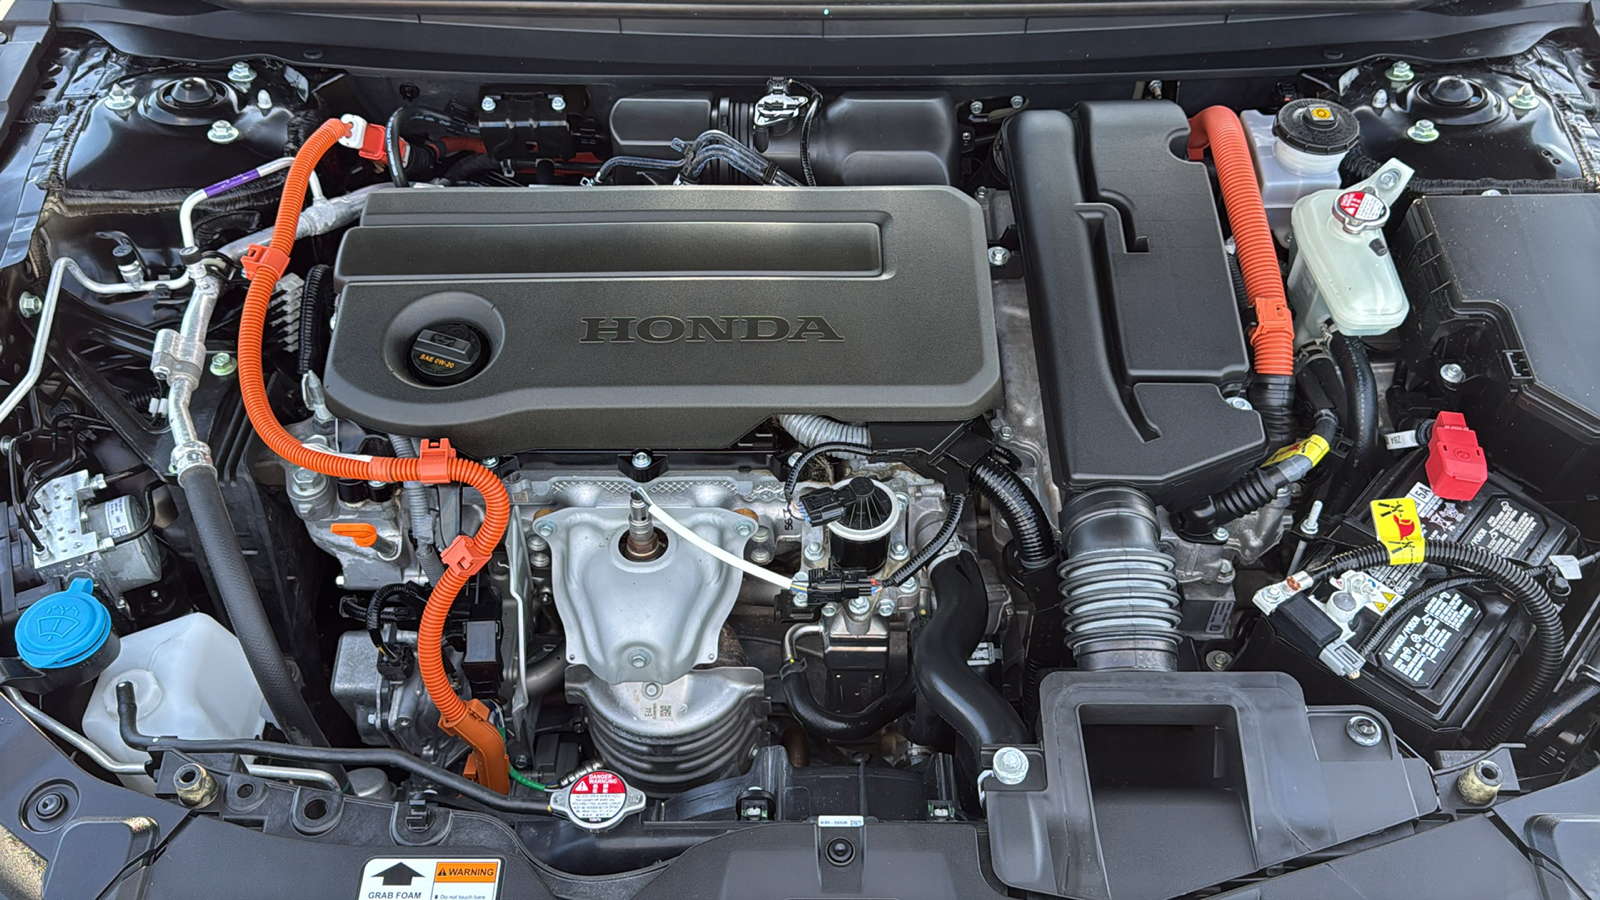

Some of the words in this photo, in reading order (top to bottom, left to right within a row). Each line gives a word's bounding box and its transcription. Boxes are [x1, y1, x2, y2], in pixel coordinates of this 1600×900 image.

[579, 315, 845, 343] HONDA
[420, 353, 435, 363] SAE
[434, 358, 454, 368] 0W-20
[448, 868, 494, 877] WARNING
[368, 891, 394, 899] GRAB
[395, 891, 422, 899] FOAM
